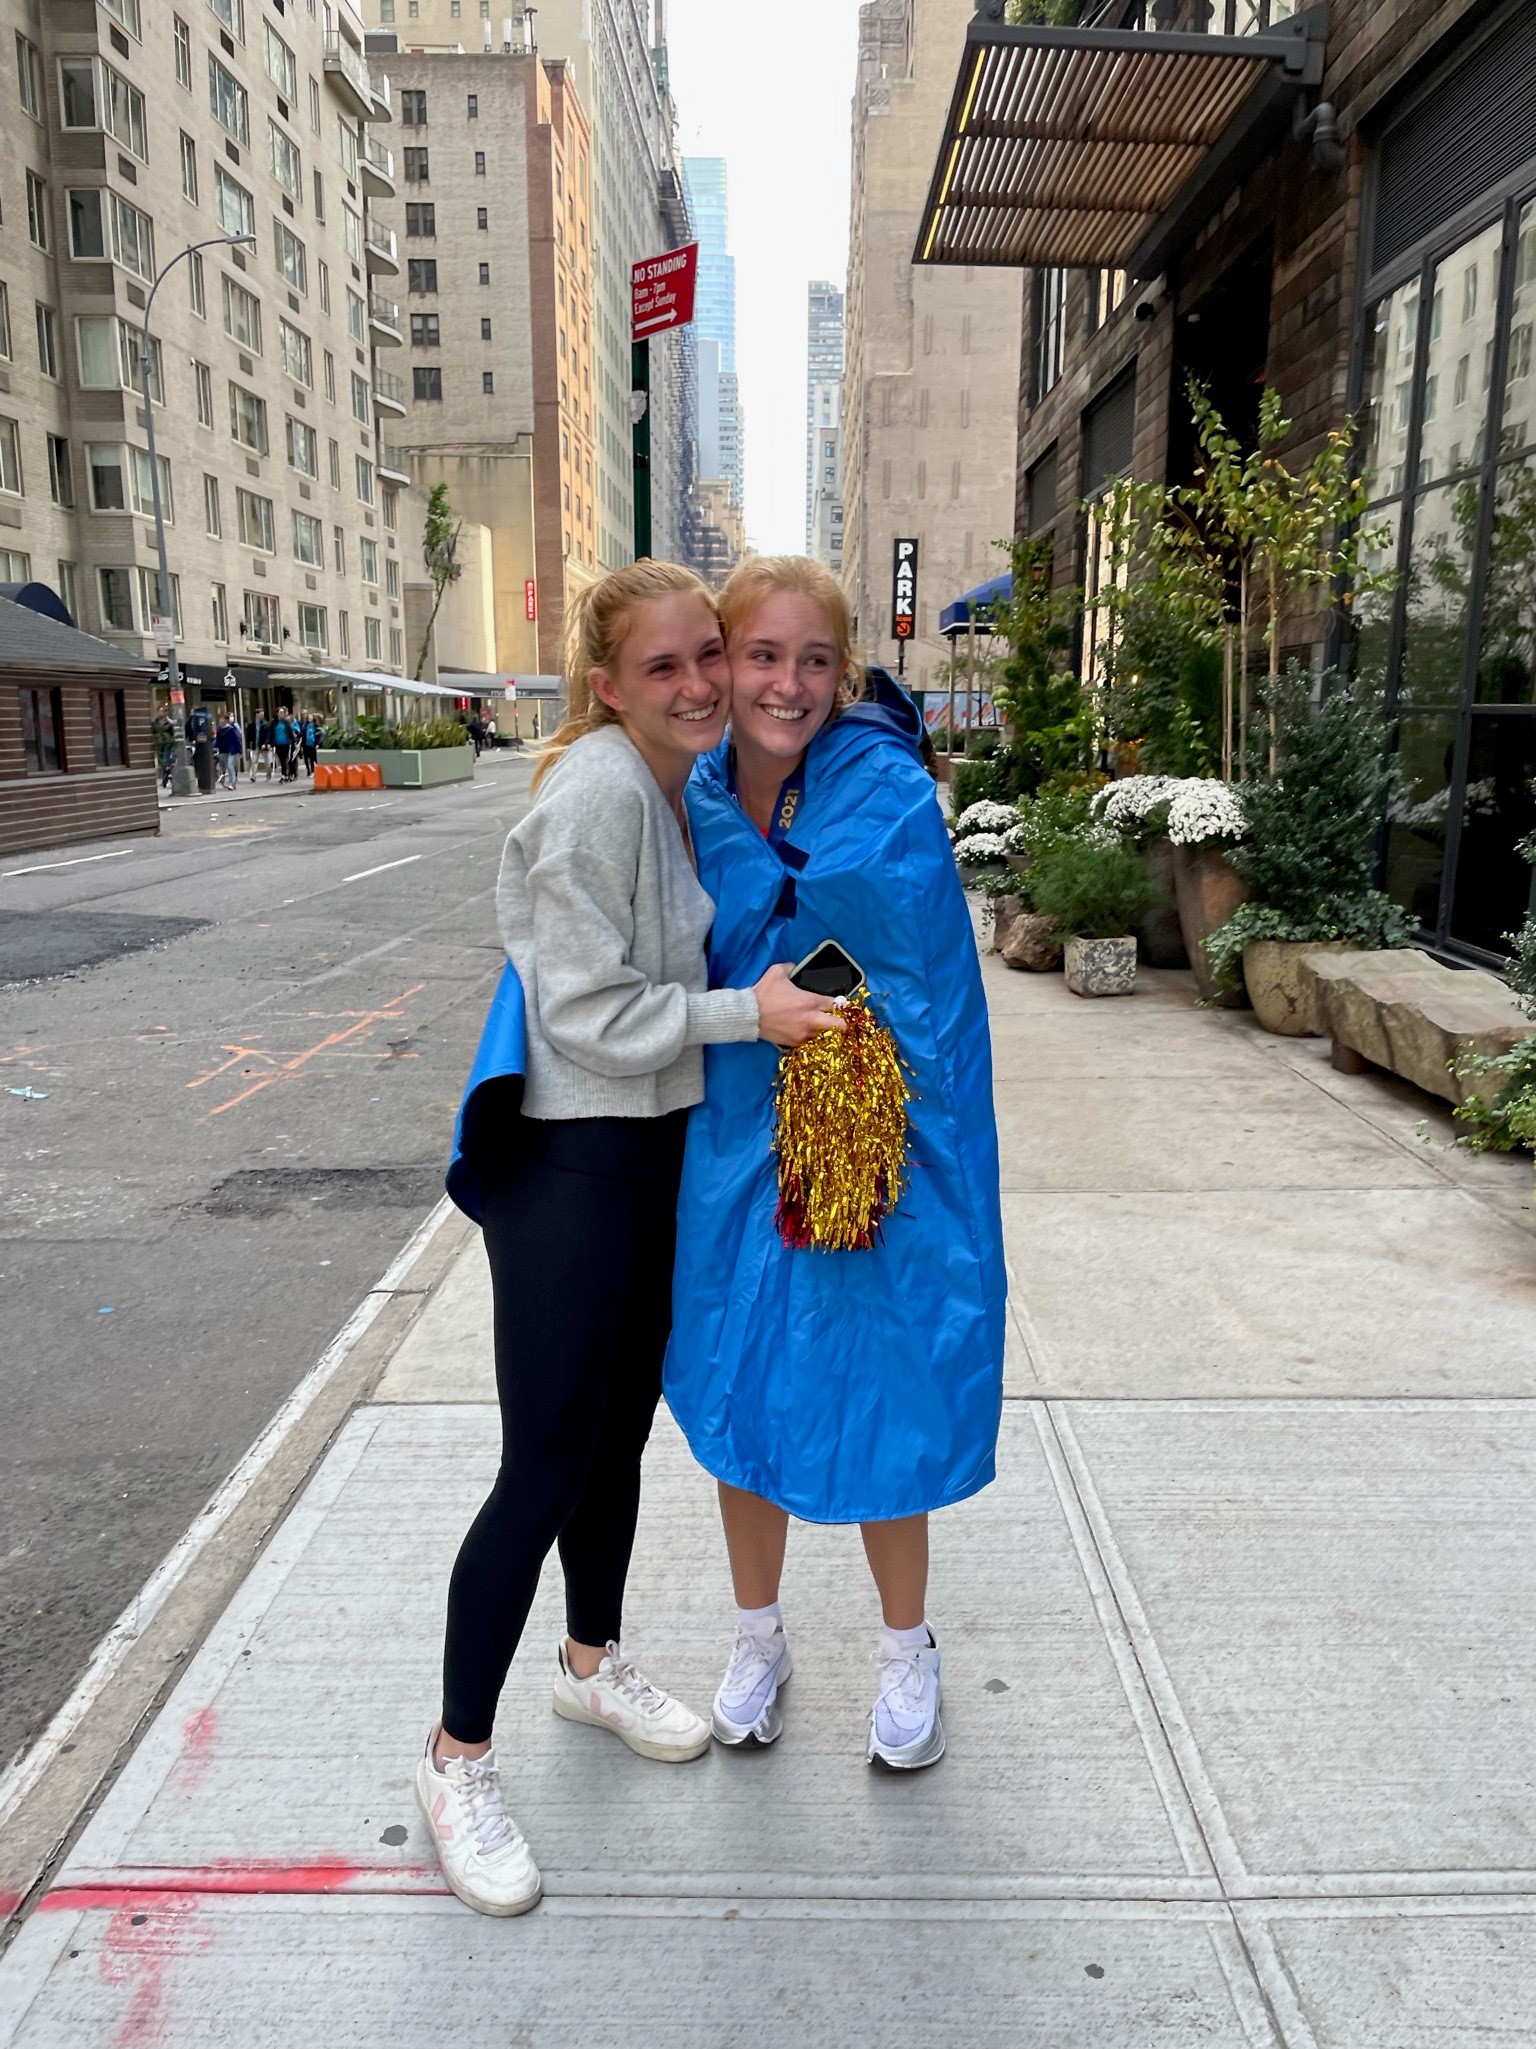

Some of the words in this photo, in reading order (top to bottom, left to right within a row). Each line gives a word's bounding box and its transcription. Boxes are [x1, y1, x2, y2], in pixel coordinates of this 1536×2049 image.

[634, 267, 646, 283] NO
[647, 254, 687, 280] STANDING
[653, 281, 666, 296] 7pm
[634, 298, 654, 315] Except
[654, 292, 677, 307] Sunday
[896, 542, 914, 615] PARK
[778, 788, 800, 828] 2021
